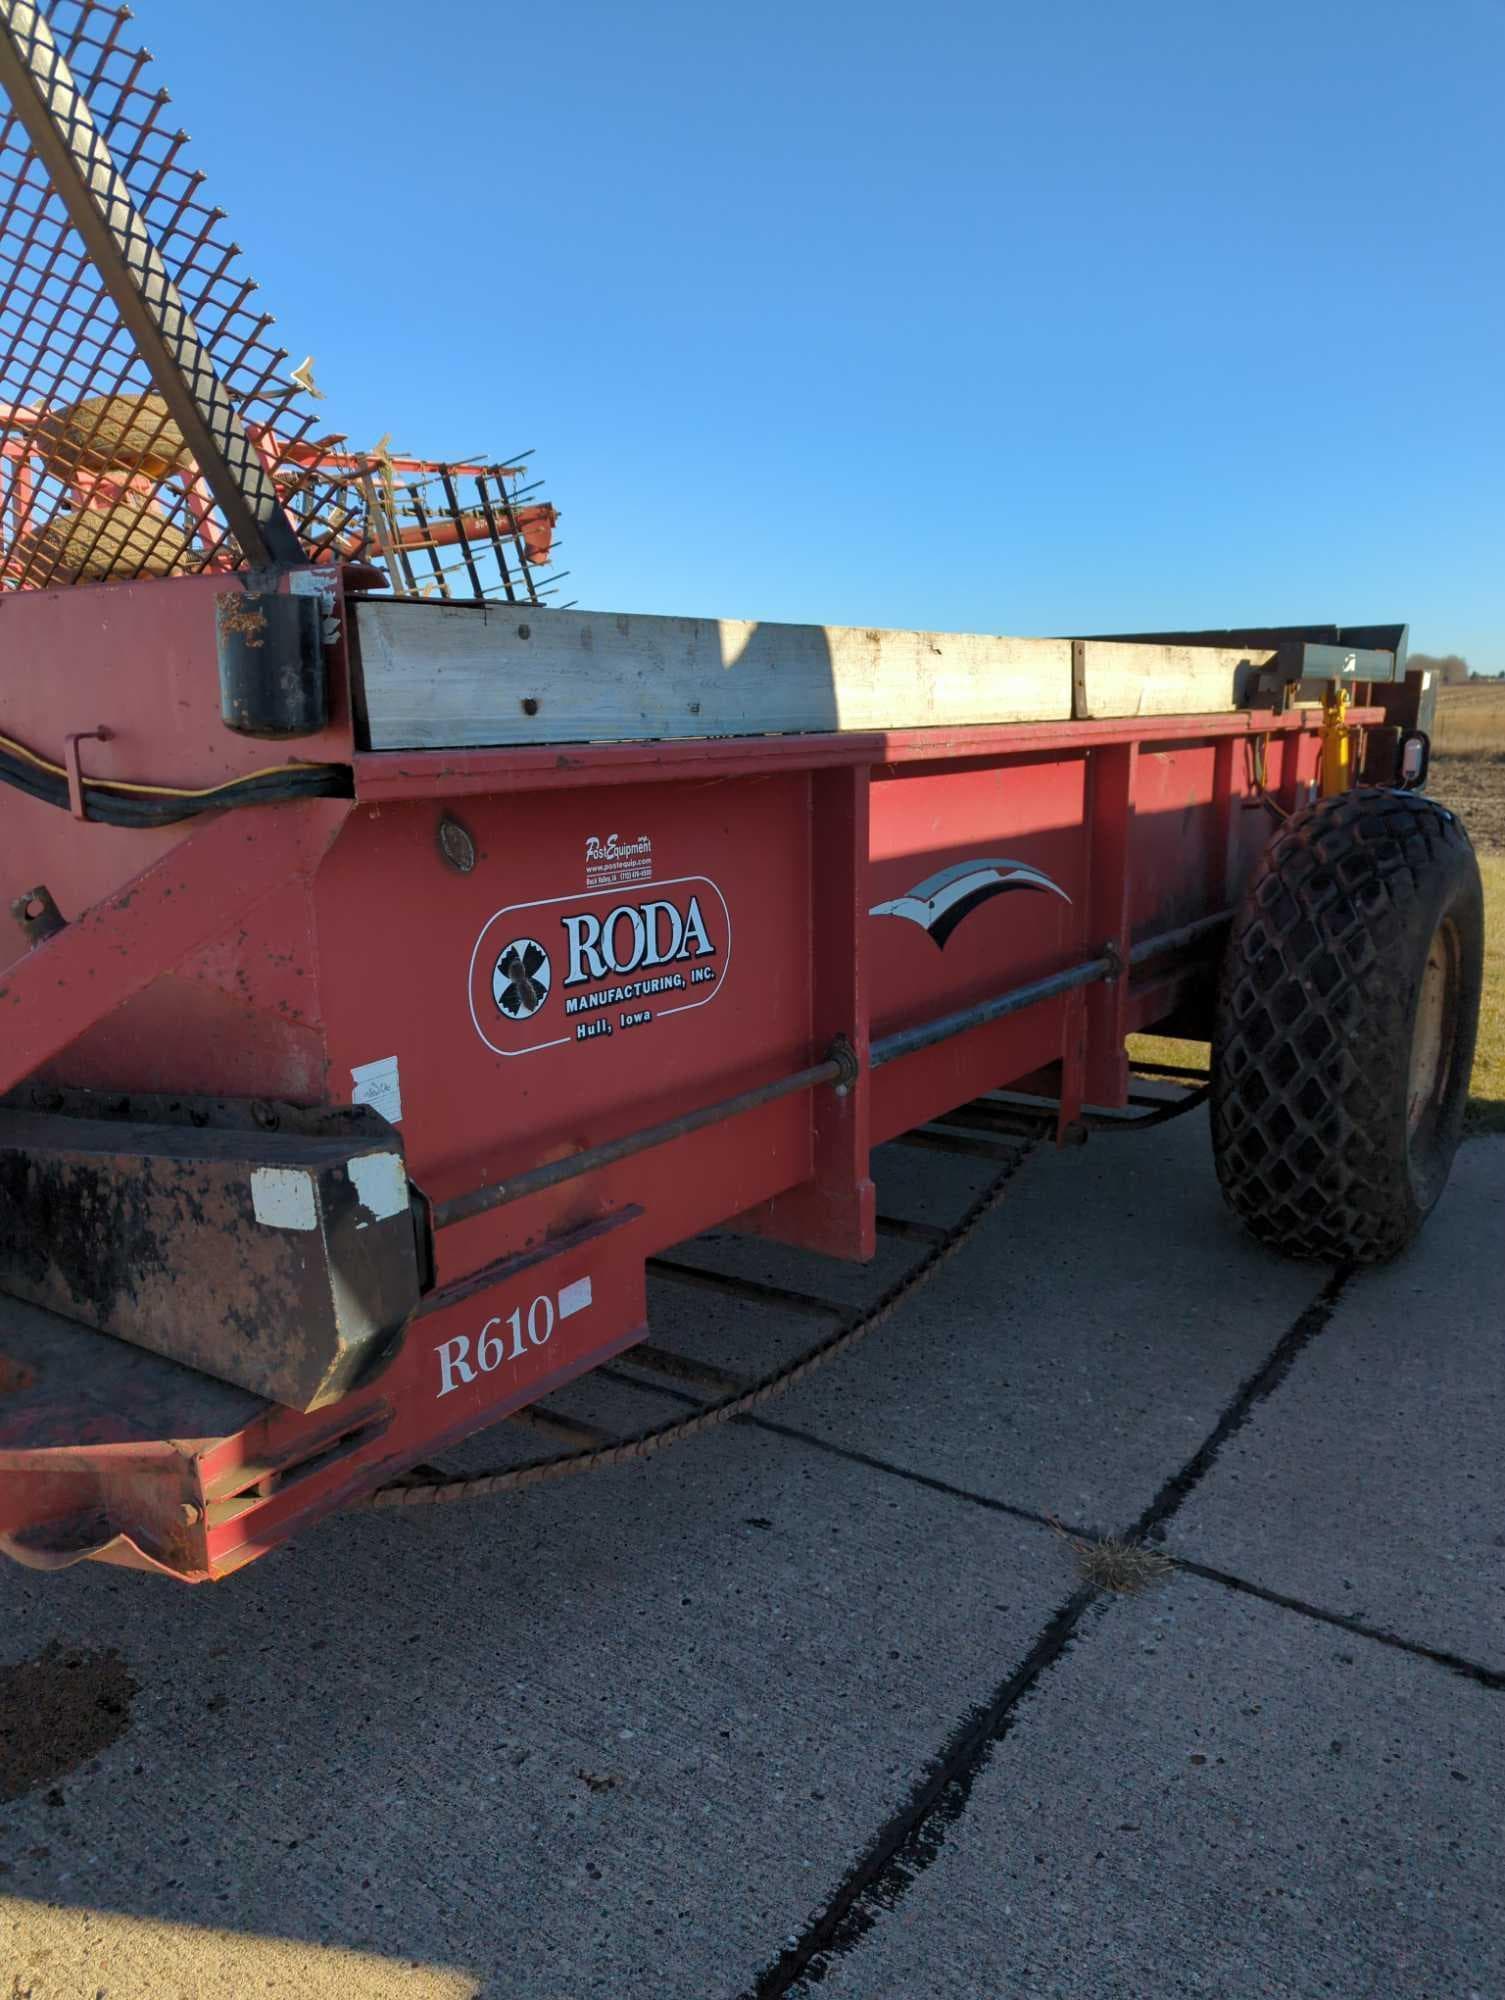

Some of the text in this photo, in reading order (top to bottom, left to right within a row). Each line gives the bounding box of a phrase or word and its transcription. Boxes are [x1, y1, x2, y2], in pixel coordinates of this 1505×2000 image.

[562, 896, 714, 987] RODA
[566, 966, 716, 1014] MANUFACTURING, INC.
[577, 1010, 652, 1040] Hull, Iowa
[433, 1295, 554, 1398] R610
